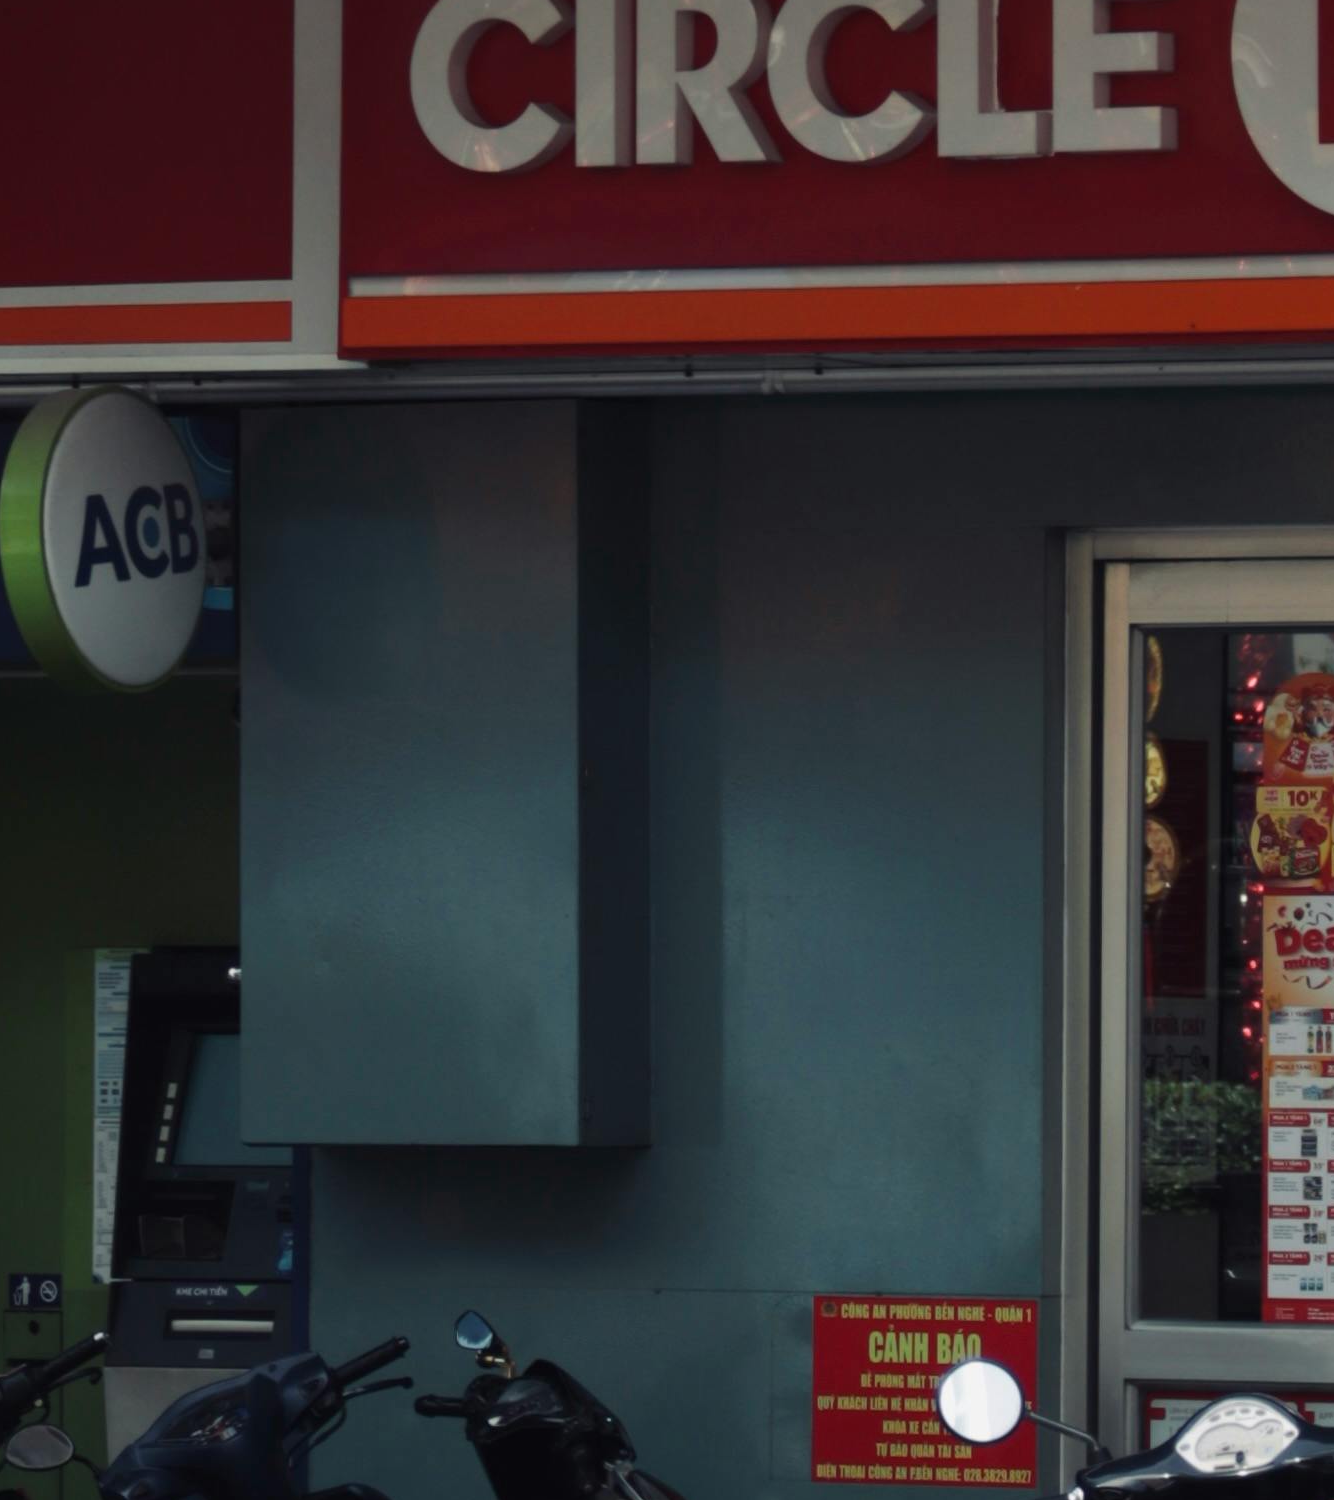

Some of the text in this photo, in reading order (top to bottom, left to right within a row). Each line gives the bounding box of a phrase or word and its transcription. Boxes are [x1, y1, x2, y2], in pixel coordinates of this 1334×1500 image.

[73, 482, 200, 588] ACB
[1286, 790, 1318, 807] 10K
[868, 1324, 982, 1364] CẢNH BÁO
